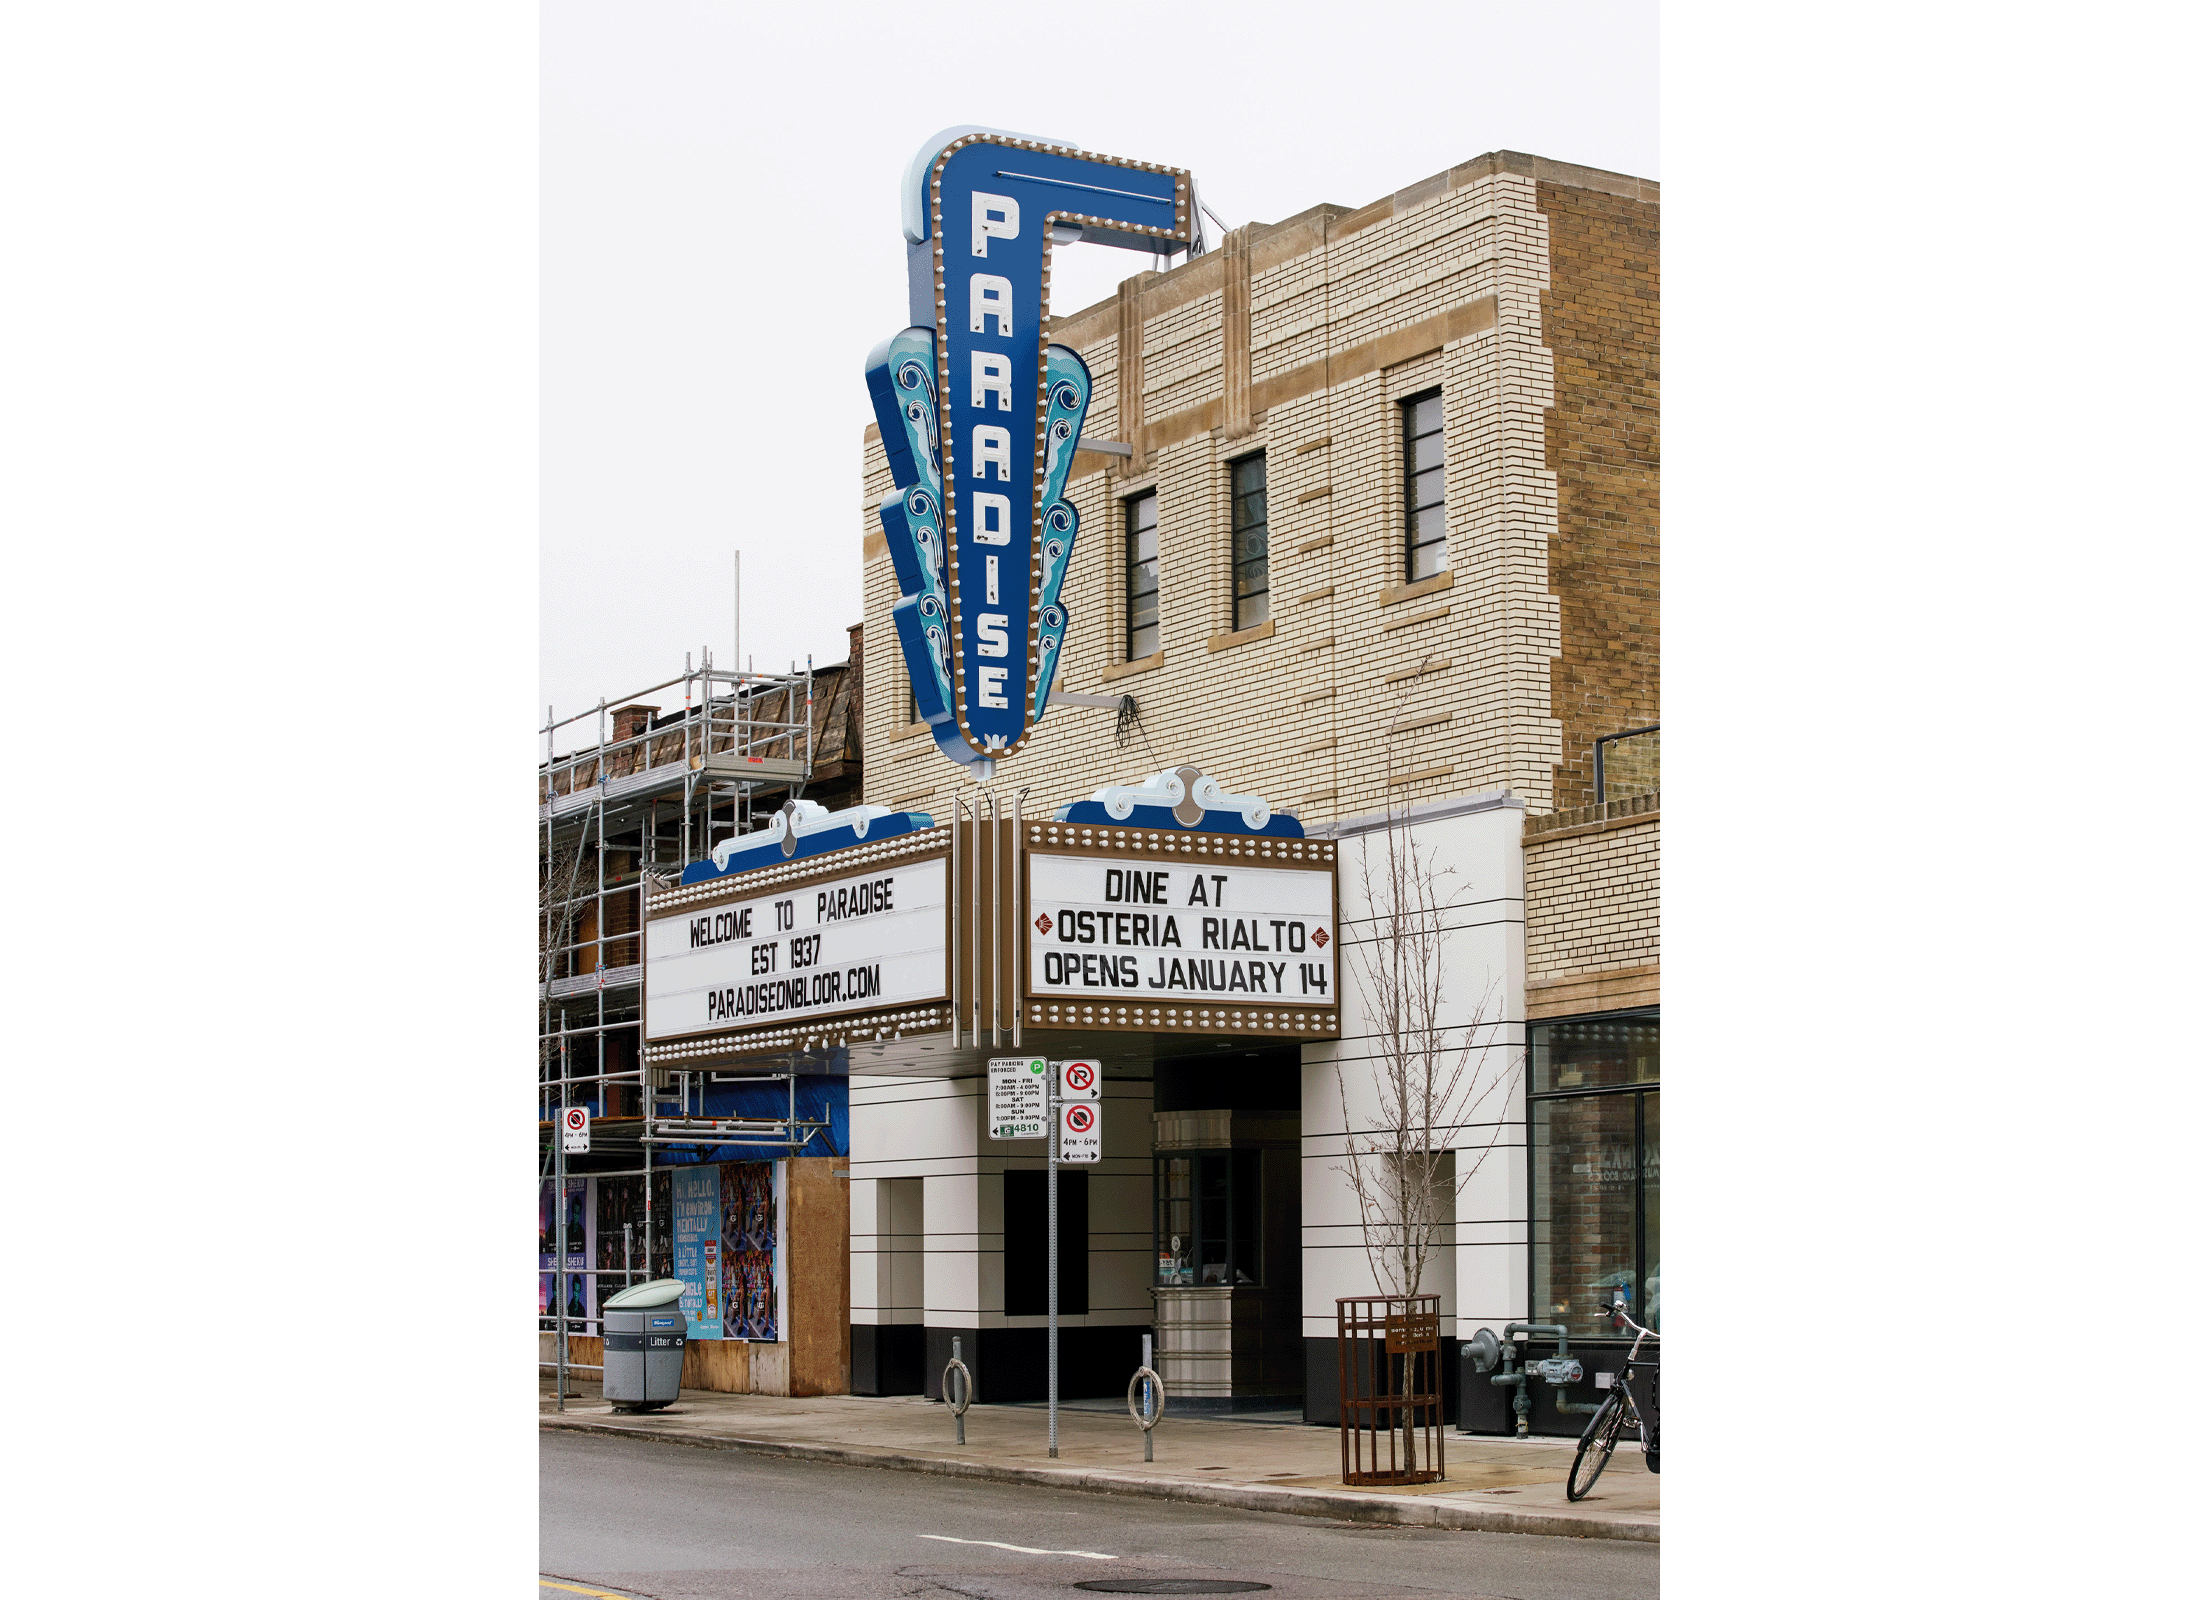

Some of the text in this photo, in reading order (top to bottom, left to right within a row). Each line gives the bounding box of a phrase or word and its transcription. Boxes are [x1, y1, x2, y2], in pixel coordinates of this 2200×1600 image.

[969, 190, 1020, 710] PARADISE
[1105, 869, 1227, 907] DINE AT
[690, 878, 893, 948] WELCOME TO PARADISE
[1058, 909, 1306, 953] OSTERIA RIALTO
[751, 934, 821, 976] EST 1937
[1044, 952, 1327, 995] OPENS JANUARY 14
[708, 964, 880, 1021] PARADISEONBLOOR.COM
[1014, 1124, 1039, 1132] 4810
[1064, 1138, 1077, 1146] 4PM
[1084, 1138, 1097, 1146] 6PM
[568, 1257, 584, 1266] SHEKU
[650, 1337, 670, 1346] Litter
